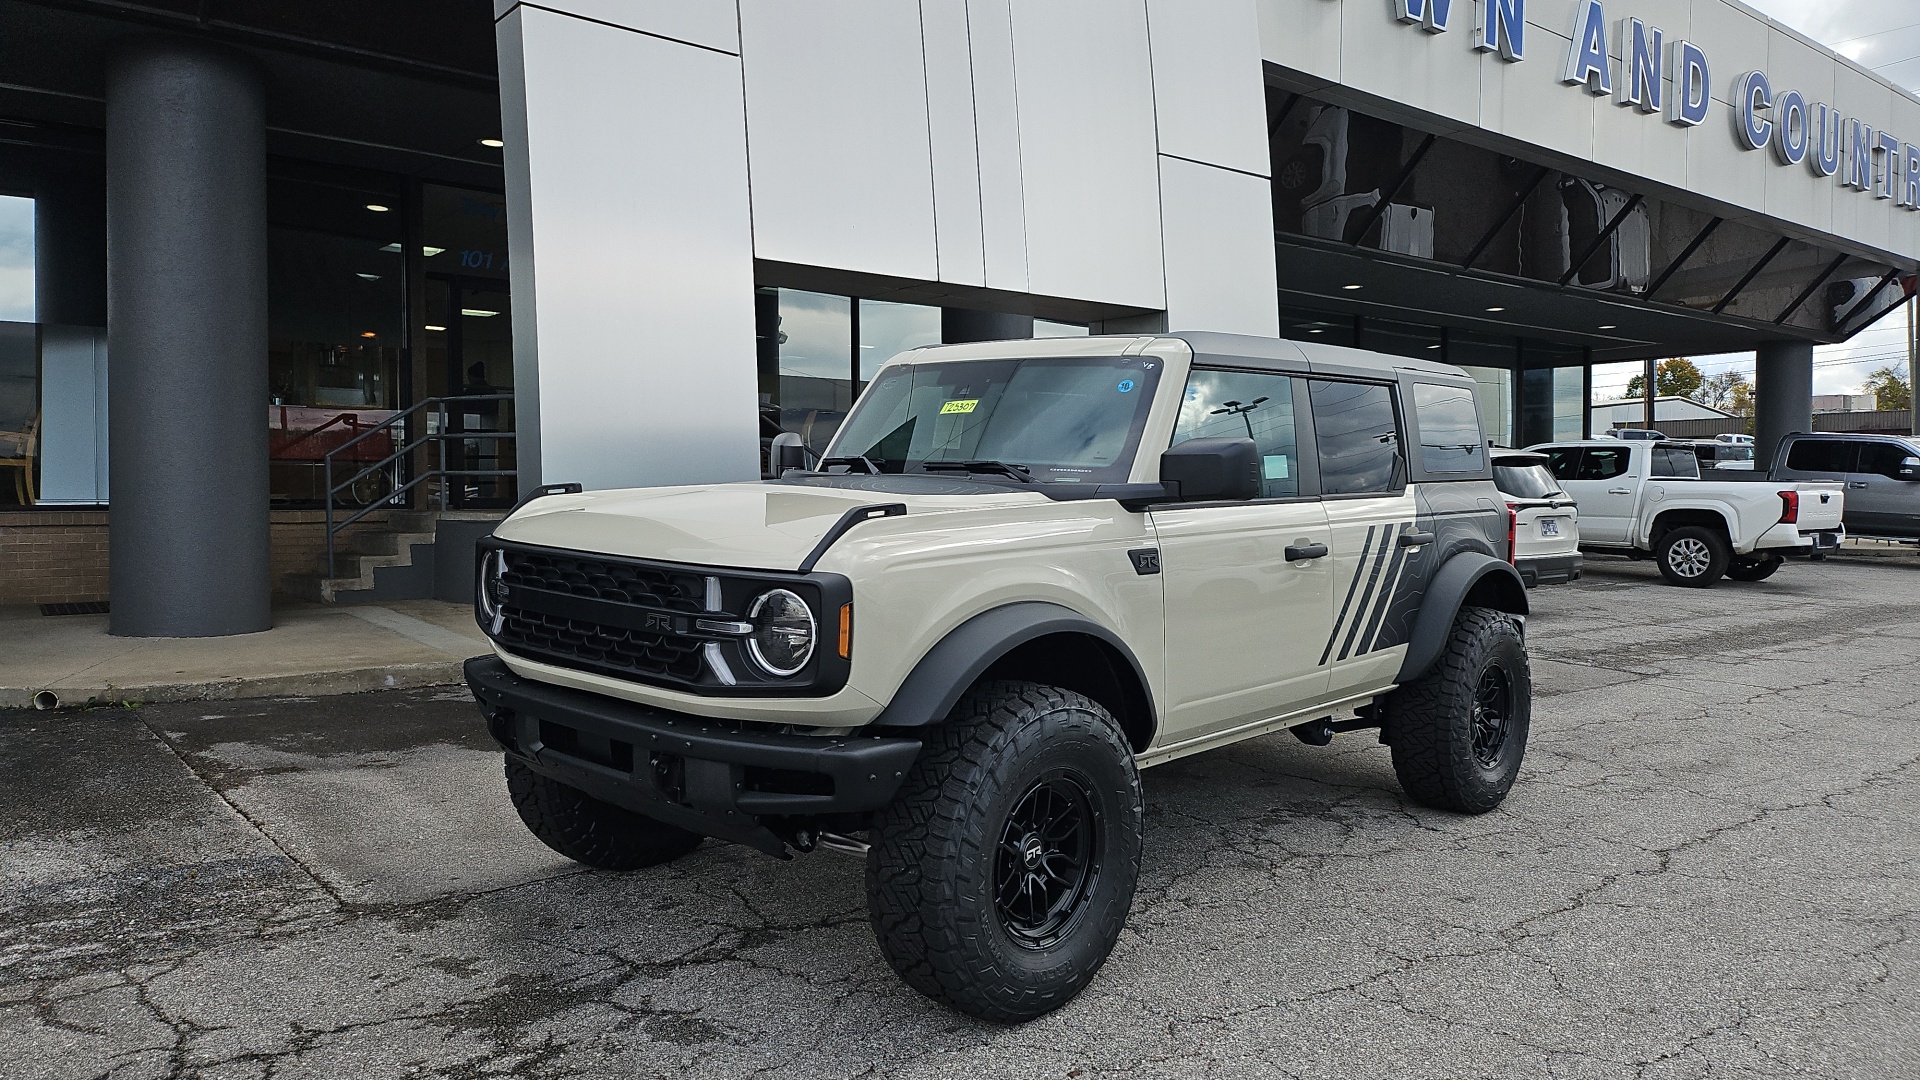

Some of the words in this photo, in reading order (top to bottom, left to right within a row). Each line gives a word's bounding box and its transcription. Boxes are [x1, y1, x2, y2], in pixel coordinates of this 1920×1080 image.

[1395, 0, 1525, 63] N
[1564, 0, 1711, 127] AND
[1735, 70, 1920, 211] COUNTR
[460, 250, 493, 269] 101
